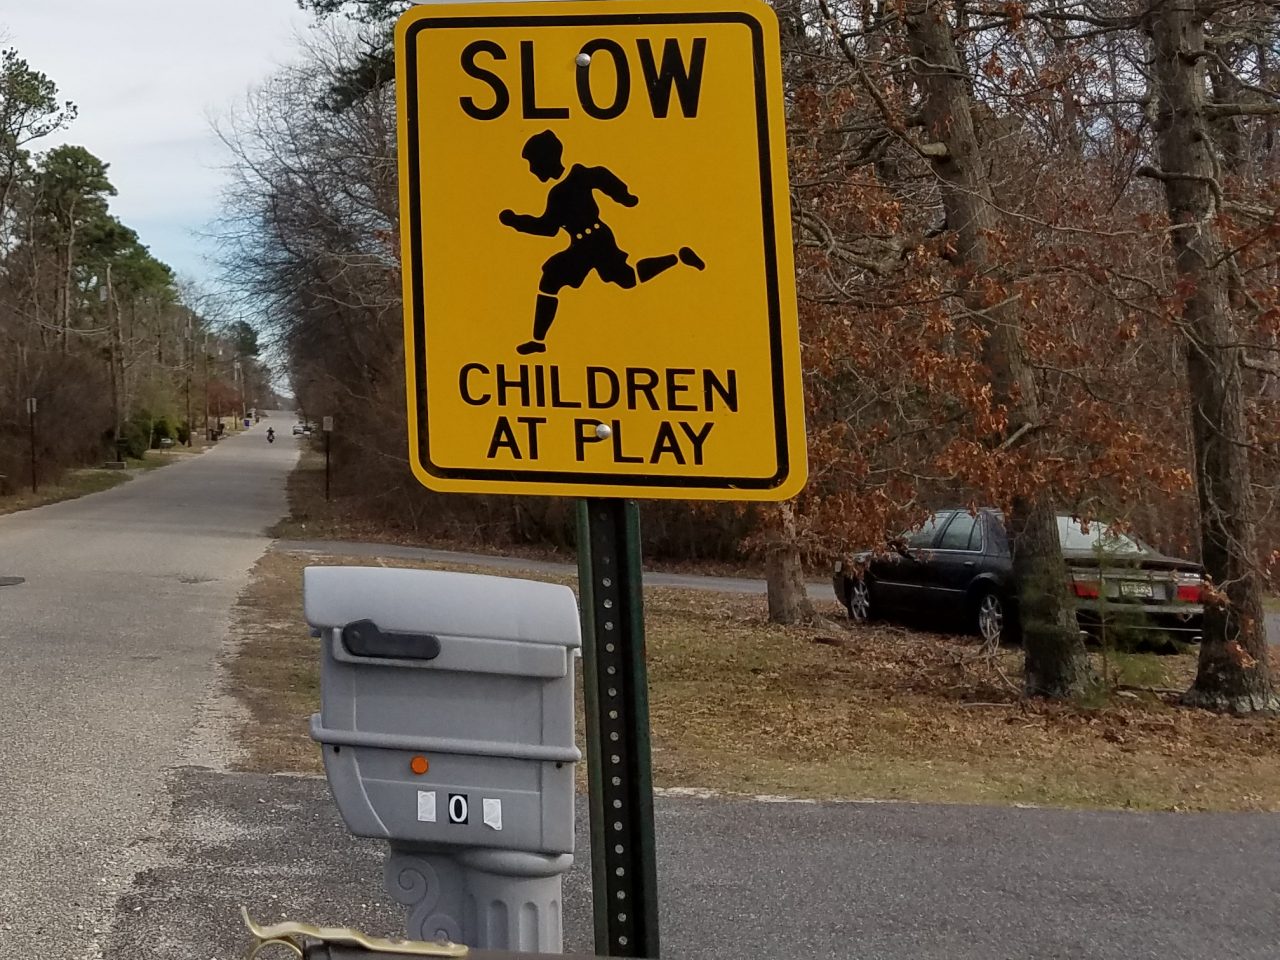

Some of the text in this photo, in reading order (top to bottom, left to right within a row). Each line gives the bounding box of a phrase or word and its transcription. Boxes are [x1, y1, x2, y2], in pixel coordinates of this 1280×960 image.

[458, 37, 708, 121] SLOW
[458, 362, 739, 413] CHILDREN
[486, 415, 715, 466] AT PLAY
[448, 794, 468, 823] 0
